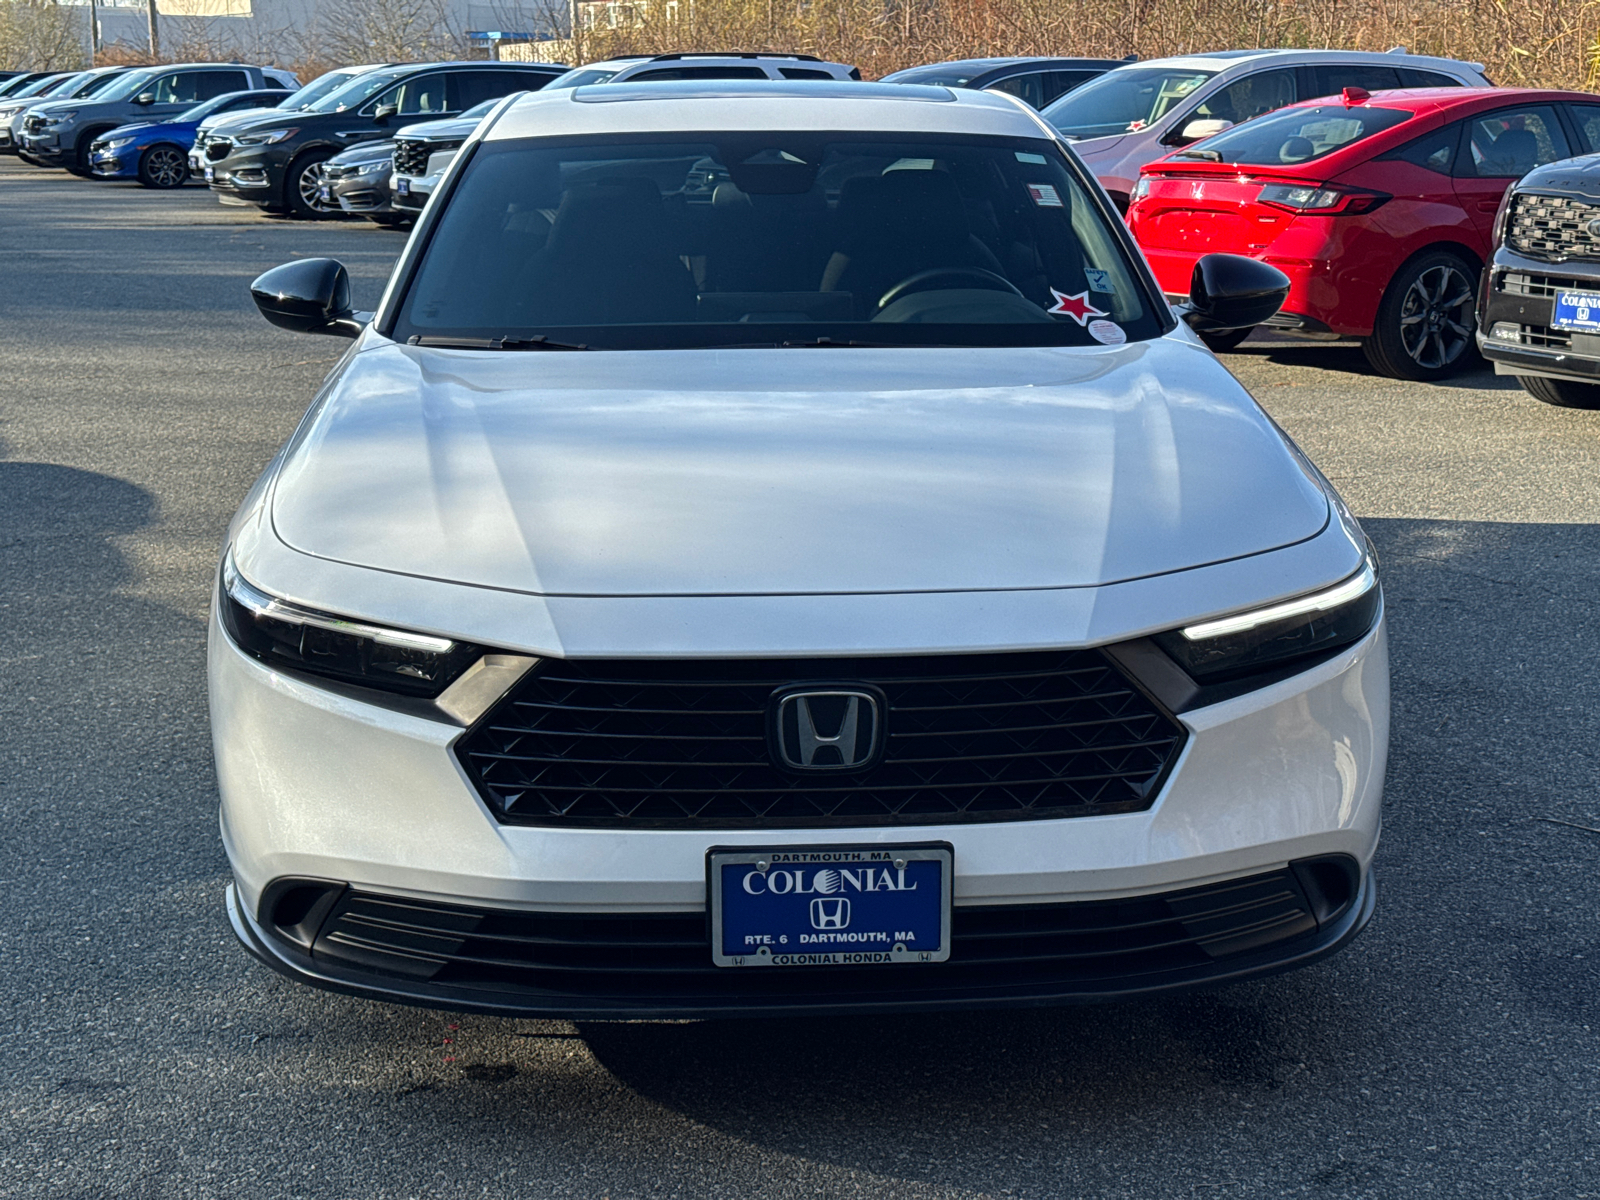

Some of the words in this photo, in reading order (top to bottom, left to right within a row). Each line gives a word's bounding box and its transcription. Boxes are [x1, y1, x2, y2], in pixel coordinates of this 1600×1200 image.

[870, 851, 892, 861] MA
[742, 868, 918, 895] COLONIAL
[744, 935, 776, 945] RTE.
[779, 934, 788, 944] 6
[799, 932, 891, 944] DARTMOUTH,
[894, 931, 916, 941] MA
[771, 954, 839, 965] COLONIAL
[843, 953, 892, 964] HONDA
